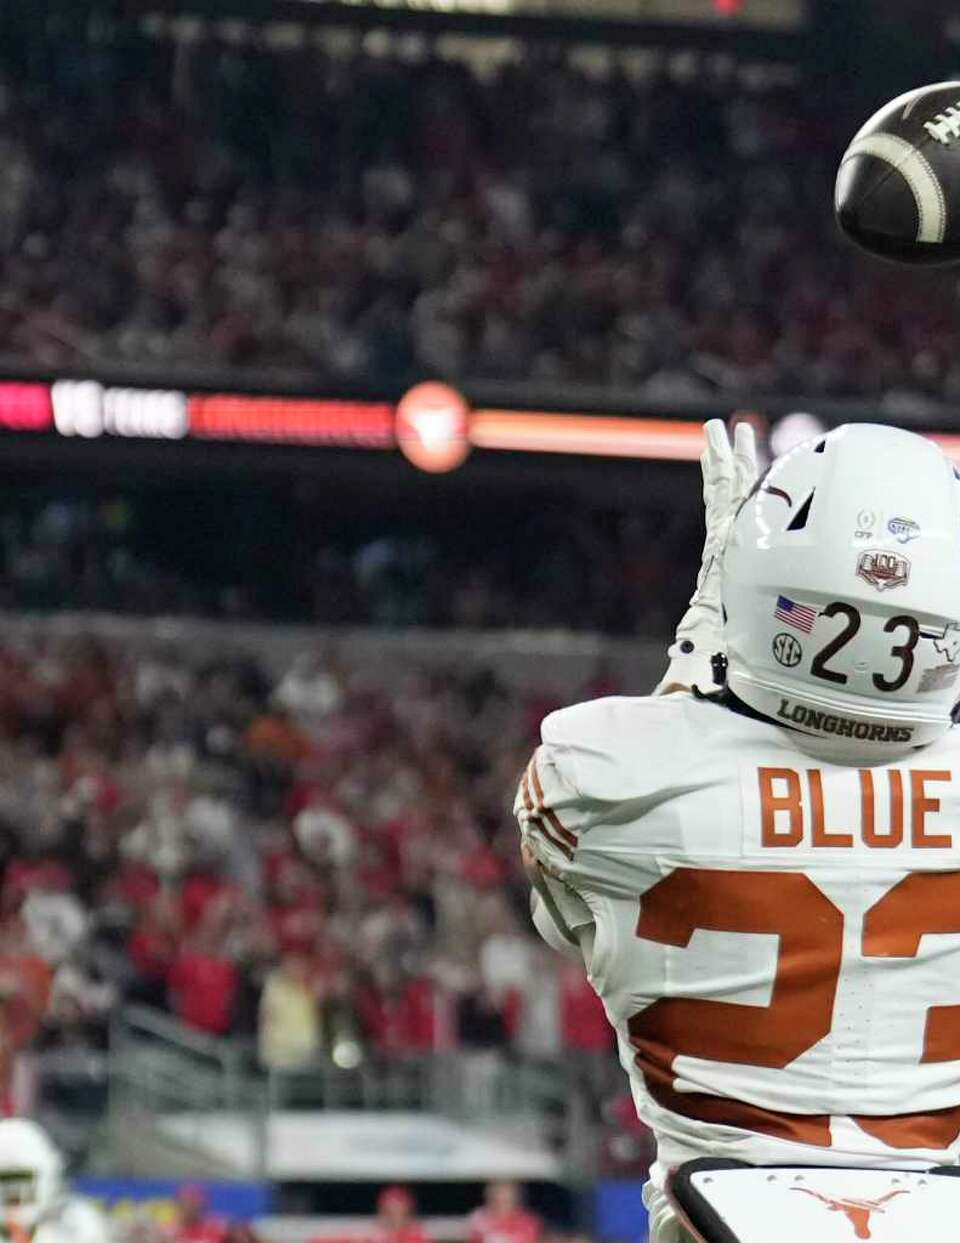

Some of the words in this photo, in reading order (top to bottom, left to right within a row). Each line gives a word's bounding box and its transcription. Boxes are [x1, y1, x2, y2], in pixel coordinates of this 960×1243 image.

[774, 635, 801, 666] SEC
[810, 602, 919, 692] 23
[776, 698, 915, 743] LONGHORNS
[757, 765, 954, 849] BLUE
